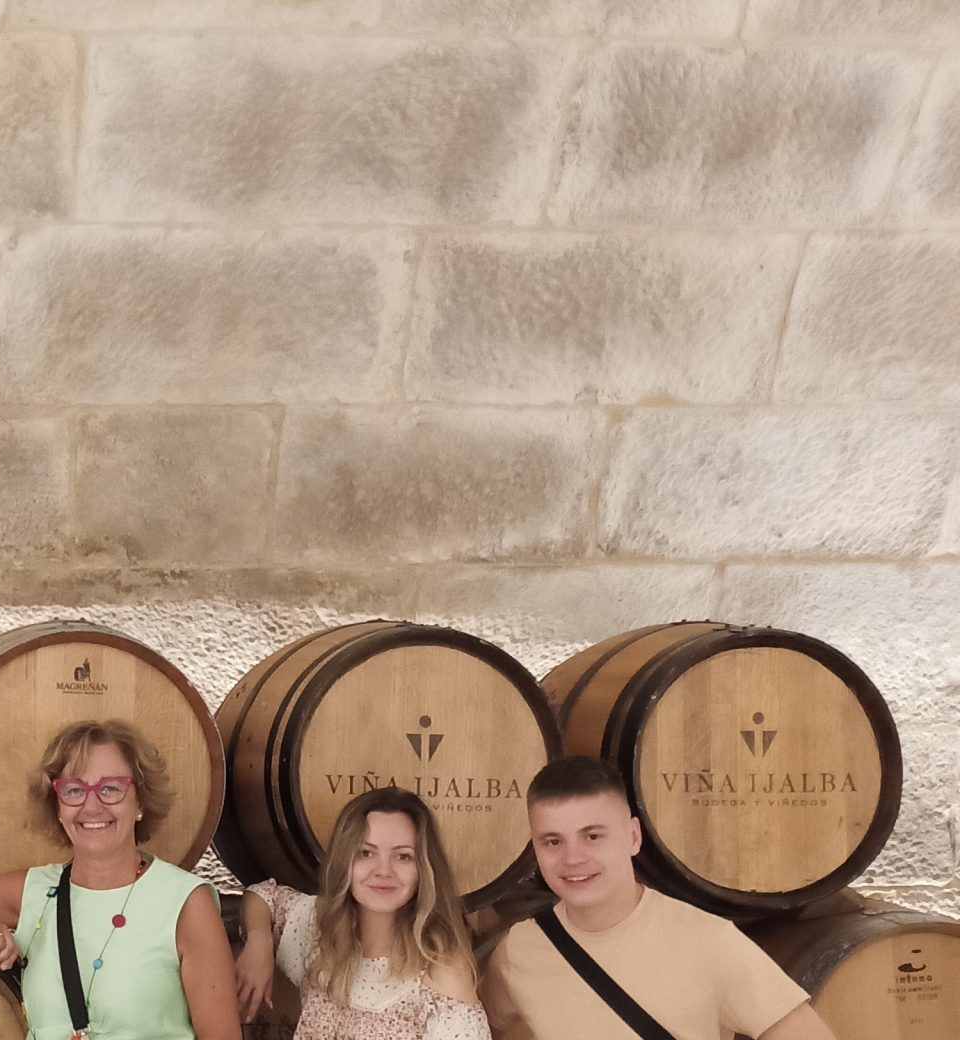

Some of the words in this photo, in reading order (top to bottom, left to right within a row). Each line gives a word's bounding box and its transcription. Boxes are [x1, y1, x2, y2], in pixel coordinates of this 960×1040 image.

[414, 776, 526, 799] IJALBA
[661, 768, 738, 793] VIÑA
[749, 771, 857, 793] IJALBA
[753, 798, 760, 807] Y
